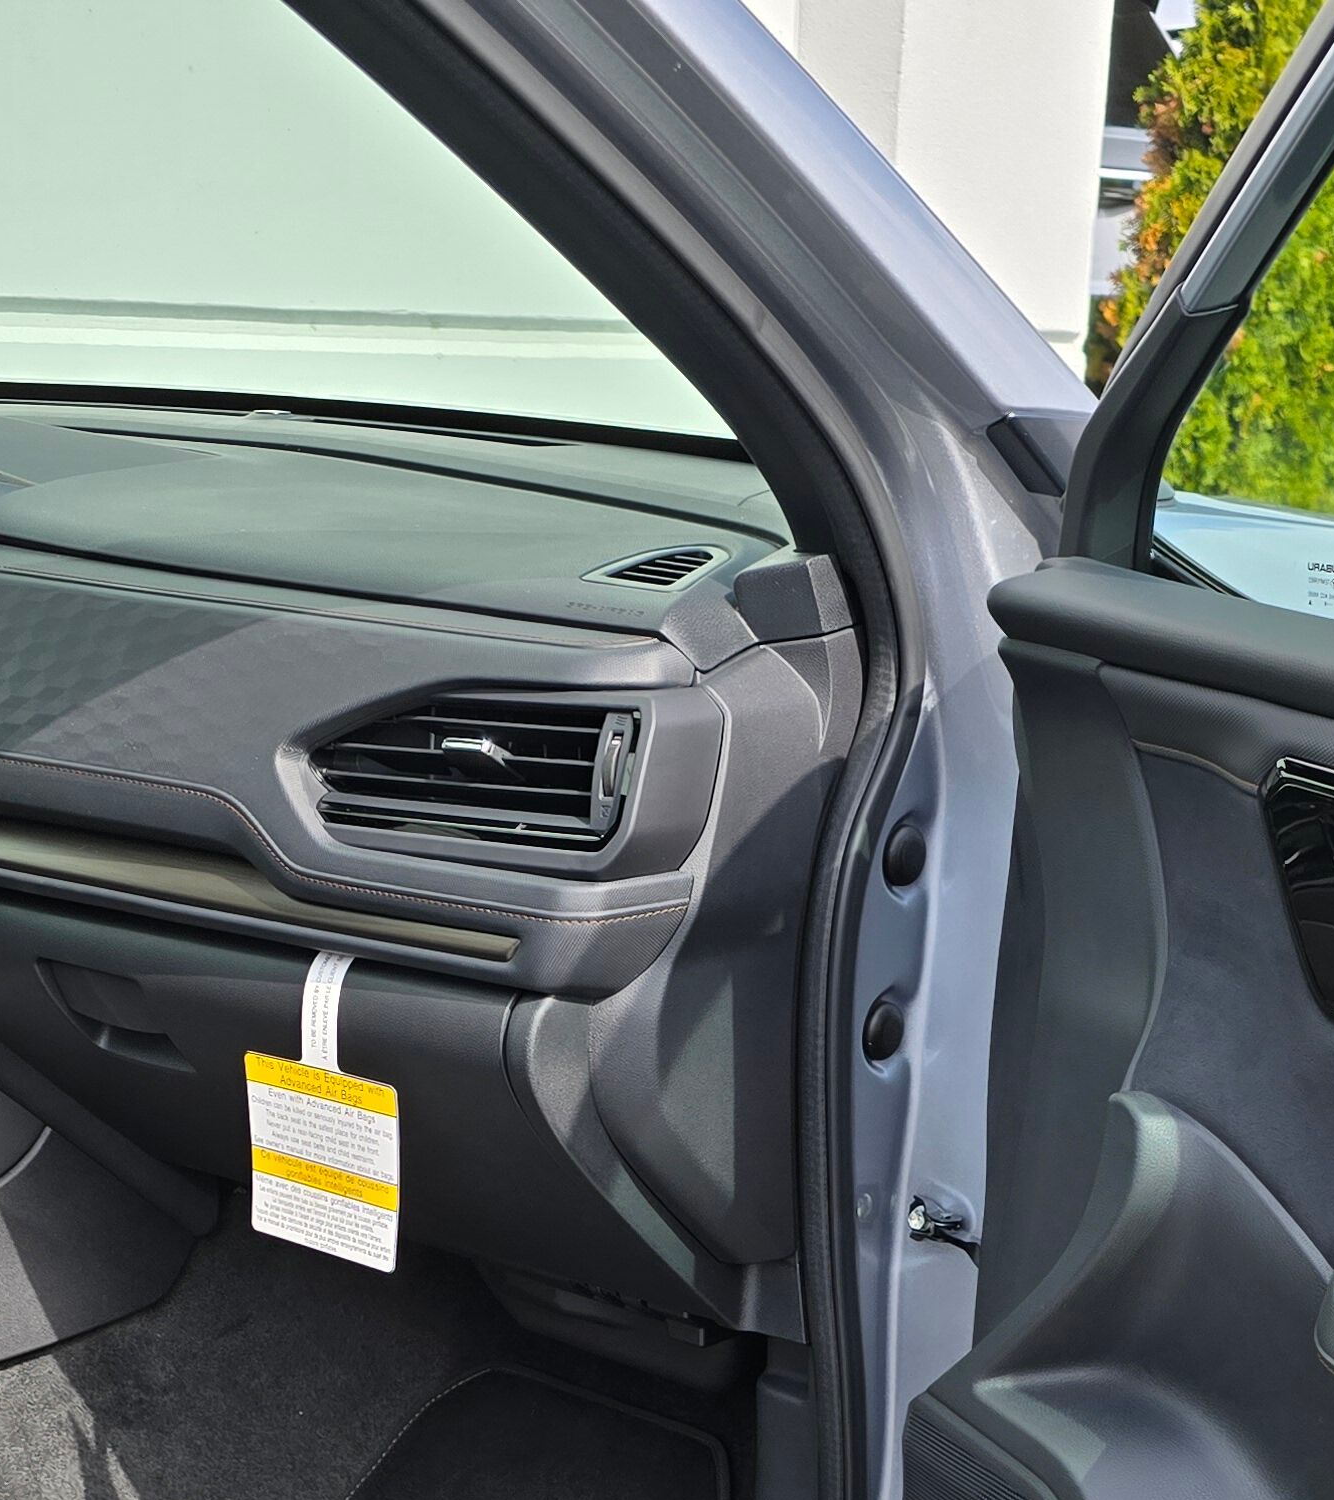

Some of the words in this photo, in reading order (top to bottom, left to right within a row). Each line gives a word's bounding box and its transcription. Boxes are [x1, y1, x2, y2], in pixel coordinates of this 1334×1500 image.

[256, 1057, 274, 1070] This
[278, 1063, 309, 1078] Vehicle
[325, 1073, 363, 1093] Equipped
[368, 1085, 384, 1097] with
[280, 1075, 321, 1093] Advanced
[326, 1086, 337, 1097] Air
[342, 1090, 362, 1107] Bags
[269, 1088, 286, 1100] Even
[290, 1094, 303, 1105] with
[307, 1098, 341, 1115] Advanced
[345, 1108, 354, 1118] Air
[358, 1111, 375, 1126] Bags
